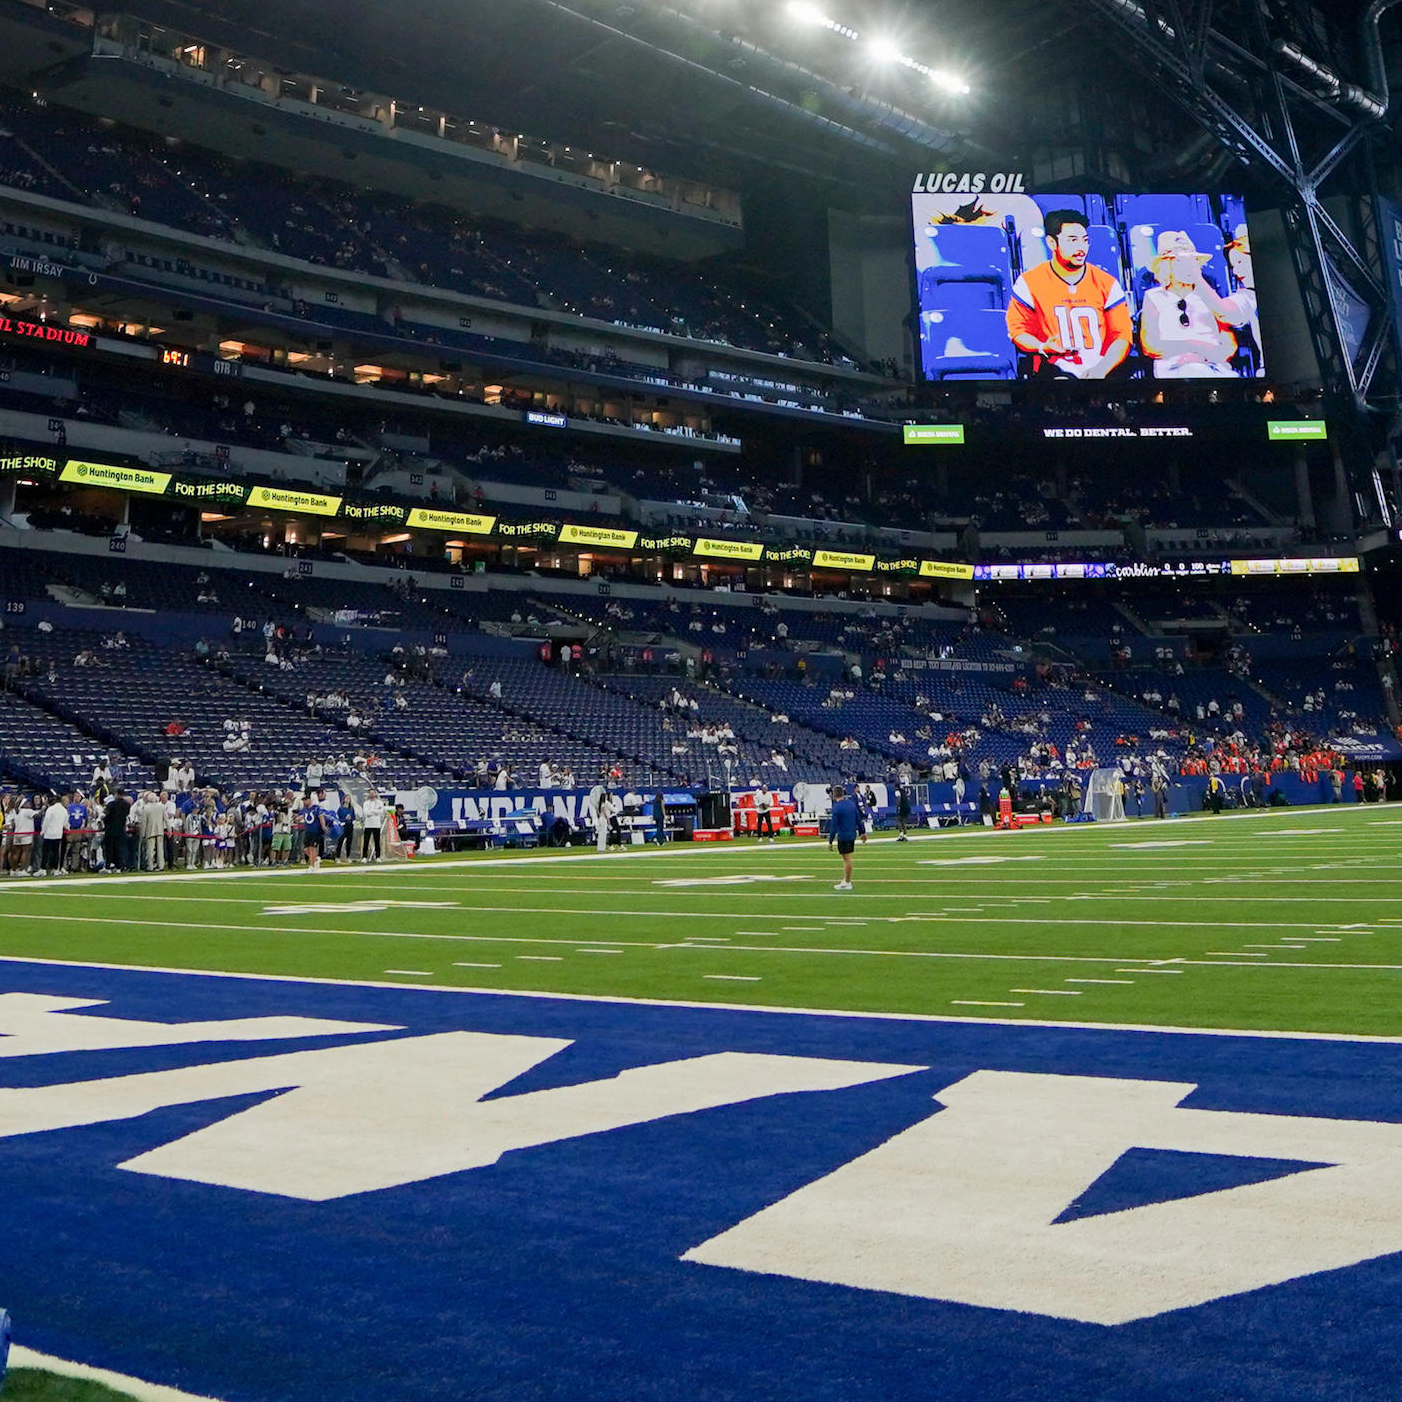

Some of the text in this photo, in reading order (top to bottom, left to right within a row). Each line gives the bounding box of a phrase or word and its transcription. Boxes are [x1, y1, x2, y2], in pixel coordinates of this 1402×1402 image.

[912, 173, 1026, 193] LUCAS OIL
[10, 257, 64, 278] JIM IRSAY
[16, 320, 91, 347] STADIUM
[1055, 306, 1098, 351] 10
[214, 360, 230, 374] QTR
[529, 412, 565, 426] BUD LIGHT
[1043, 428, 1194, 437] WE DO DENTAL. BETTER.
[0, 456, 22, 468] THE
[22, 456, 57, 472] SHOE!
[89, 468, 155, 485] Huntington Bank
[175, 482, 244, 497] FOR THE SHOE!
[271, 493, 327, 507] Huntington Bank
[345, 505, 404, 518] FOR THE SHOE!
[428, 513, 482, 527] Huntington Bank
[499, 523, 556, 535] FOR THE SHOE!
[110, 541, 126, 551] 240
[640, 538, 655, 549] FOR
[656, 539, 670, 549] THE
[766, 550, 779, 561] FOR
[779, 550, 793, 560] THE
[6, 602, 25, 613] 139
[242, 620, 257, 630] 140
